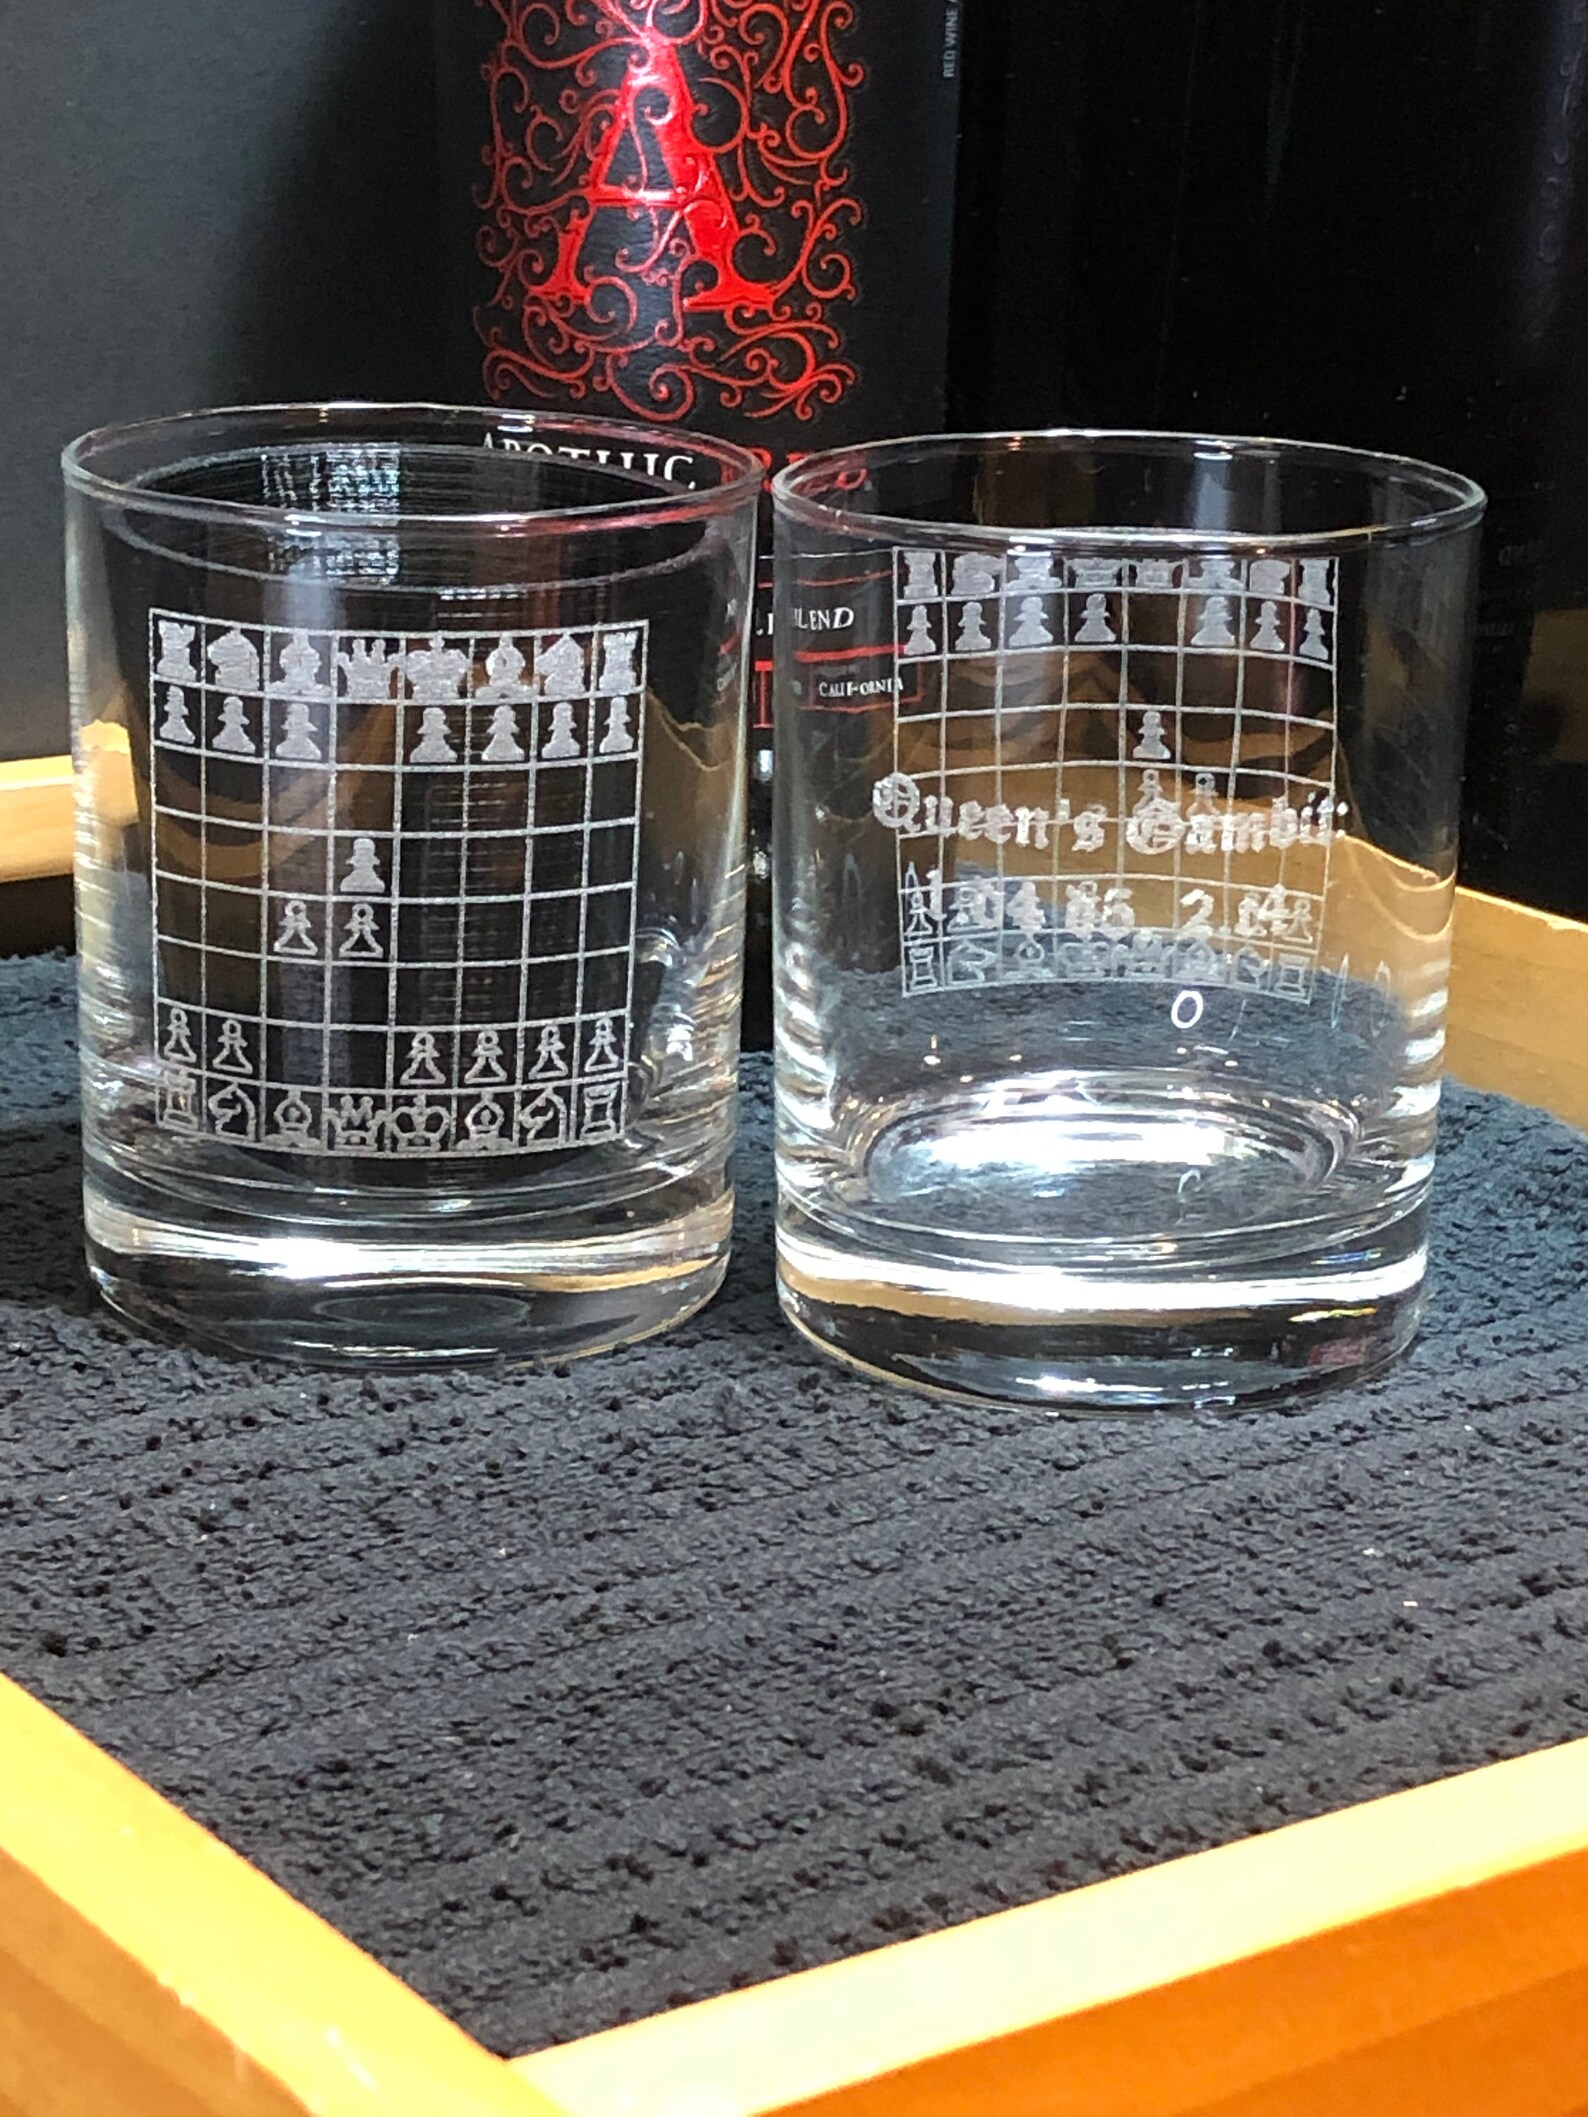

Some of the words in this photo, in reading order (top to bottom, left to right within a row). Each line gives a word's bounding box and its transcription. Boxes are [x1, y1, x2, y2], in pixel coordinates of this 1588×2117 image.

[944, 8, 959, 47] WINE
[942, 50, 957, 78] RED
[872, 772, 1109, 853] Queen's
